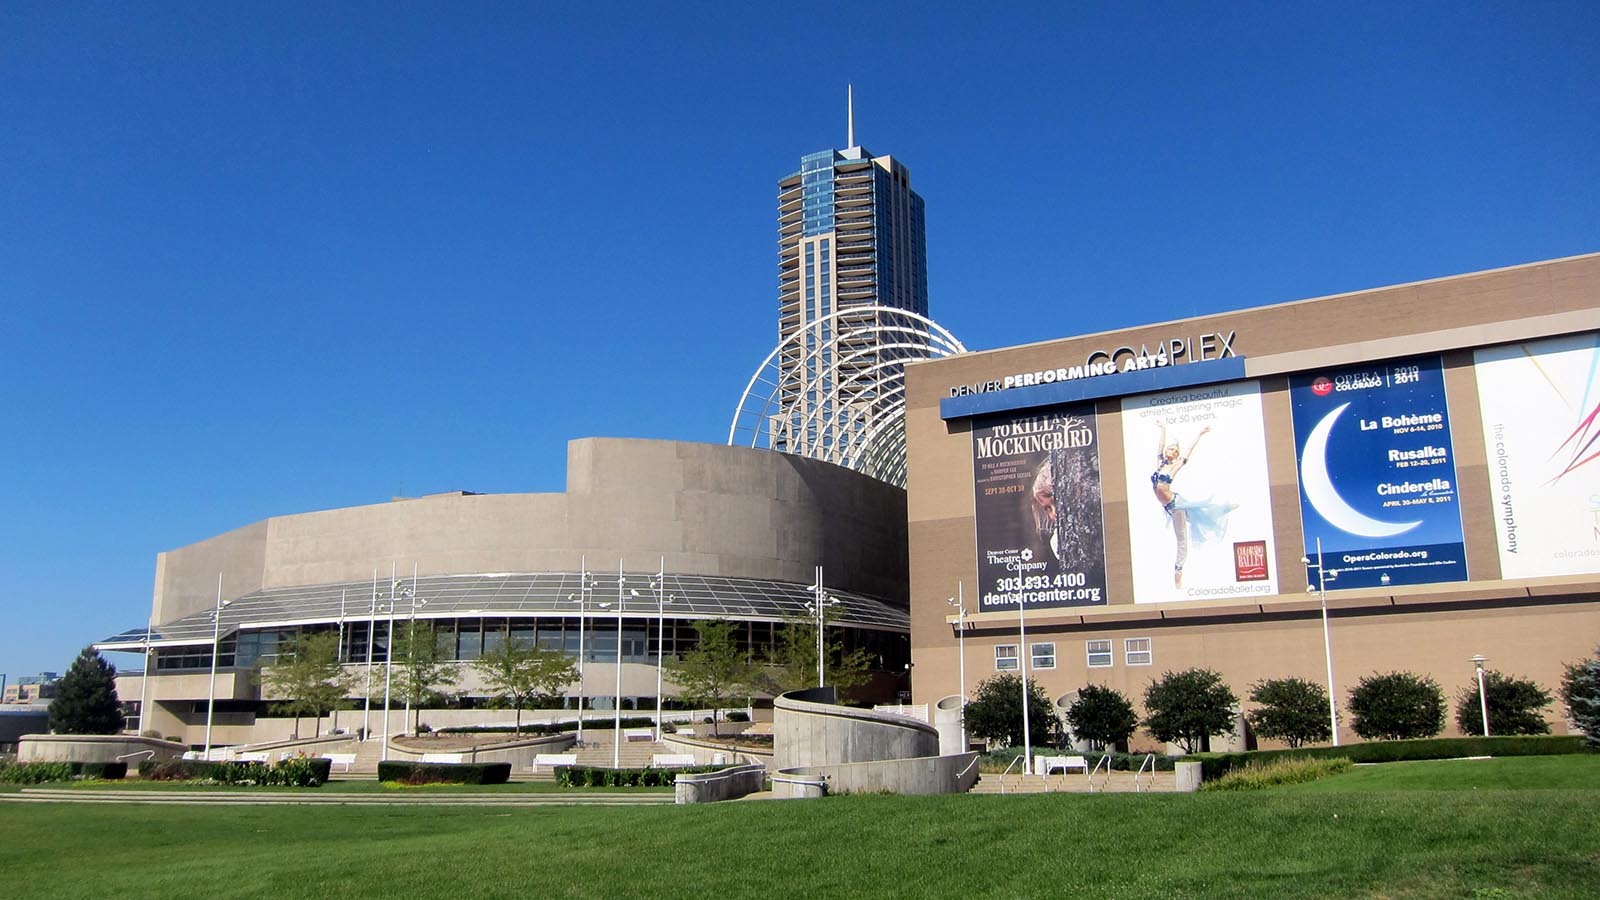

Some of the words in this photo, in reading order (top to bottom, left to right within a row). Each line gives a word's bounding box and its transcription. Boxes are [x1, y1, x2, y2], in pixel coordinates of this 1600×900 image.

[950, 380, 1002, 397] DENVER
[1004, 361, 1117, 388] PERFORMING
[1123, 354, 1168, 372] ARTS
[1335, 371, 1381, 384] OPERA
[1394, 365, 1419, 375] 2010
[1335, 379, 1382, 392] COLORADO
[1394, 374, 1419, 384] 2011
[1149, 395, 1188, 406] Creating
[1176, 402, 1212, 414] inspiring
[1213, 398, 1243, 409] magic
[992, 424, 1010, 438] TO
[1011, 415, 1054, 435] KILL
[1165, 416, 1177, 425] for
[1179, 414, 1190, 423] 50
[1360, 419, 1378, 431] La
[1382, 413, 1442, 428] Bohème
[1493, 423, 1505, 440] the
[977, 427, 1093, 459] MOCKINGBIRD
[1388, 446, 1447, 461] Rusalka
[1496, 441, 1512, 493] colorado
[985, 487, 998, 496] SEPT
[1376, 478, 1450, 495] Cinderella
[1501, 494, 1518, 554] symphony
[987, 555, 1020, 564] Theatre
[1238, 555, 1264, 568] BALLET
[1342, 550, 1428, 564] OperaColorado.org
[1006, 561, 1048, 572] Company
[996, 573, 1086, 591] 303.893.4100
[1187, 584, 1271, 597] ColoradoBallet.org
[983, 587, 1101, 605] denvercenter.org
